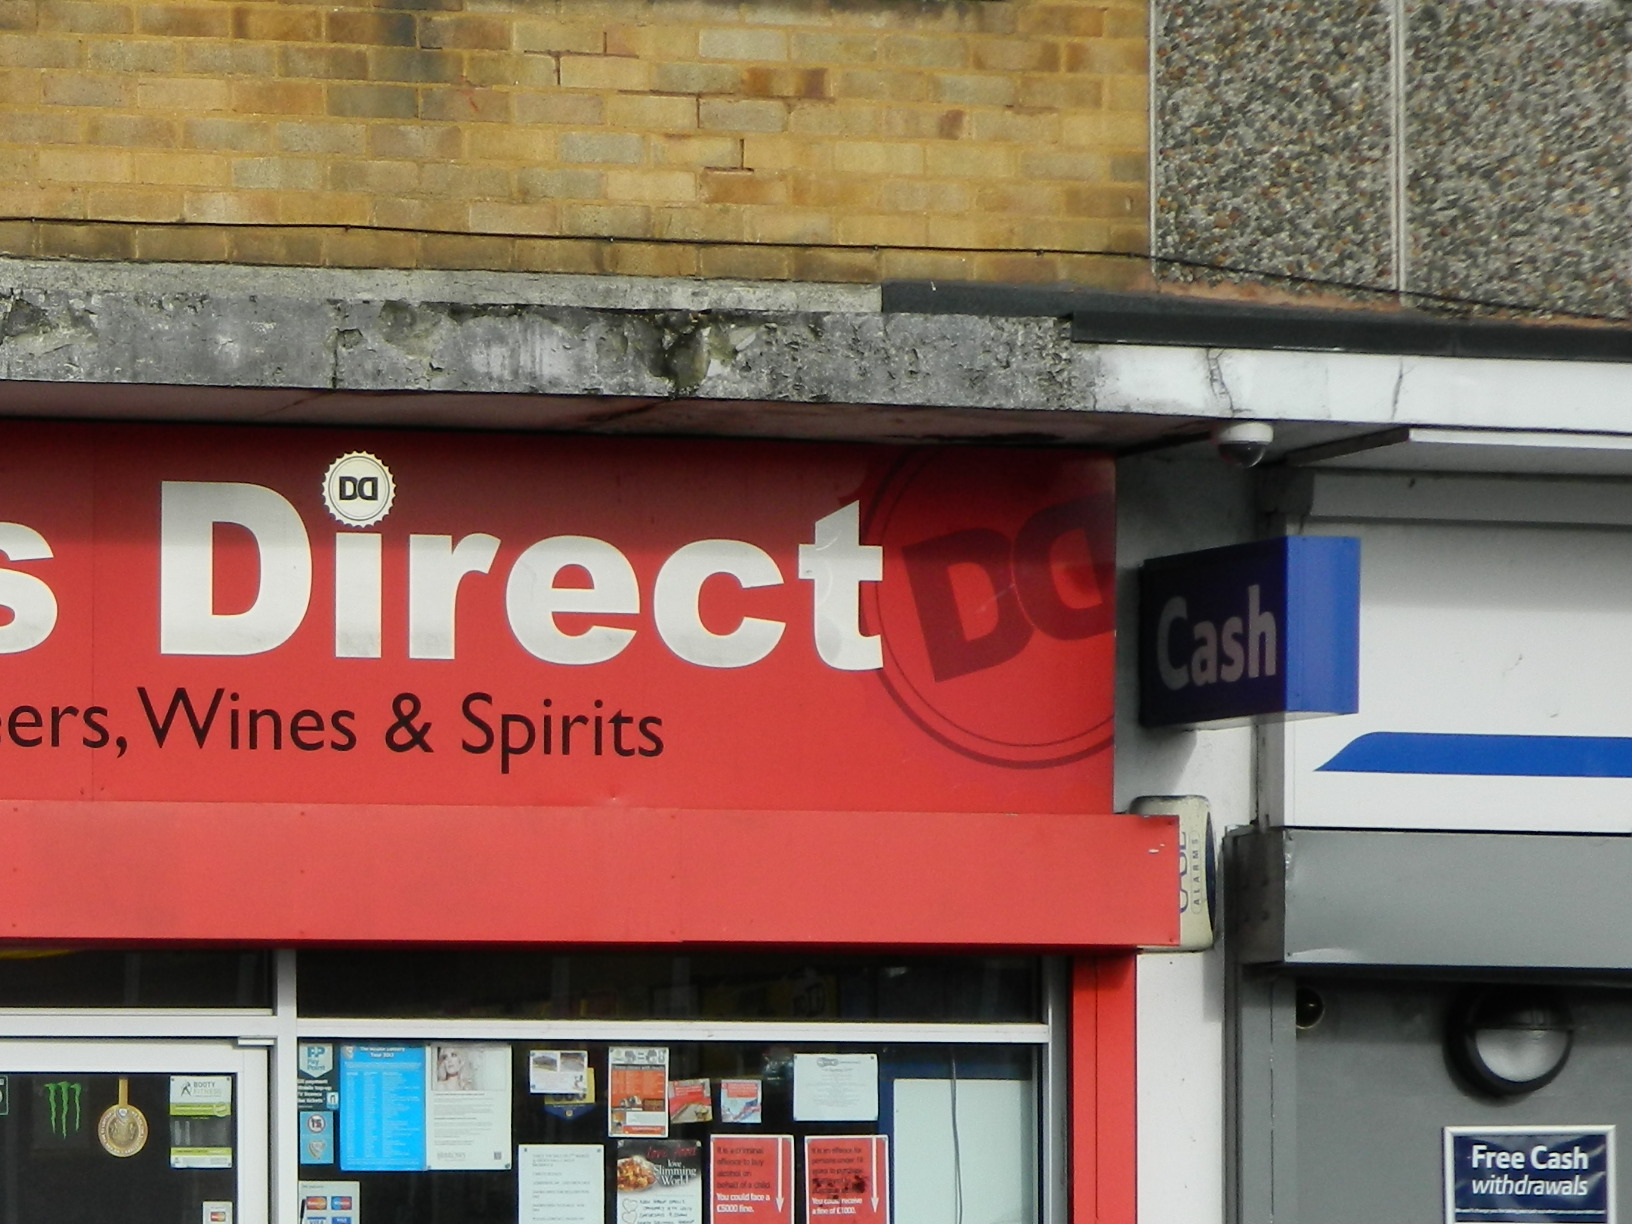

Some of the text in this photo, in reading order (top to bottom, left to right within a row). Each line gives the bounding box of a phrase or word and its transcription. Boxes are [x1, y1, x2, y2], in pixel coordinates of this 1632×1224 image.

[159, 470, 883, 672] Direct
[1156, 584, 1278, 691] Cash
[384, 692, 436, 754] &
[460, 692, 664, 774] Spirits
[1192, 838, 1200, 906] ALARMS
[751, 1159, 764, 1167] buy
[1471, 1144, 1589, 1170] Free Cash
[667, 1159, 682, 1168] love
[653, 1165, 697, 1177] Slimming
[660, 1175, 689, 1186] World
[1471, 1173, 1589, 1196] withdrawals
[716, 1193, 729, 1201] You
[730, 1193, 750, 1201] could
[739, 1204, 755, 1213] fine.
[816, 1207, 829, 1215] fine
